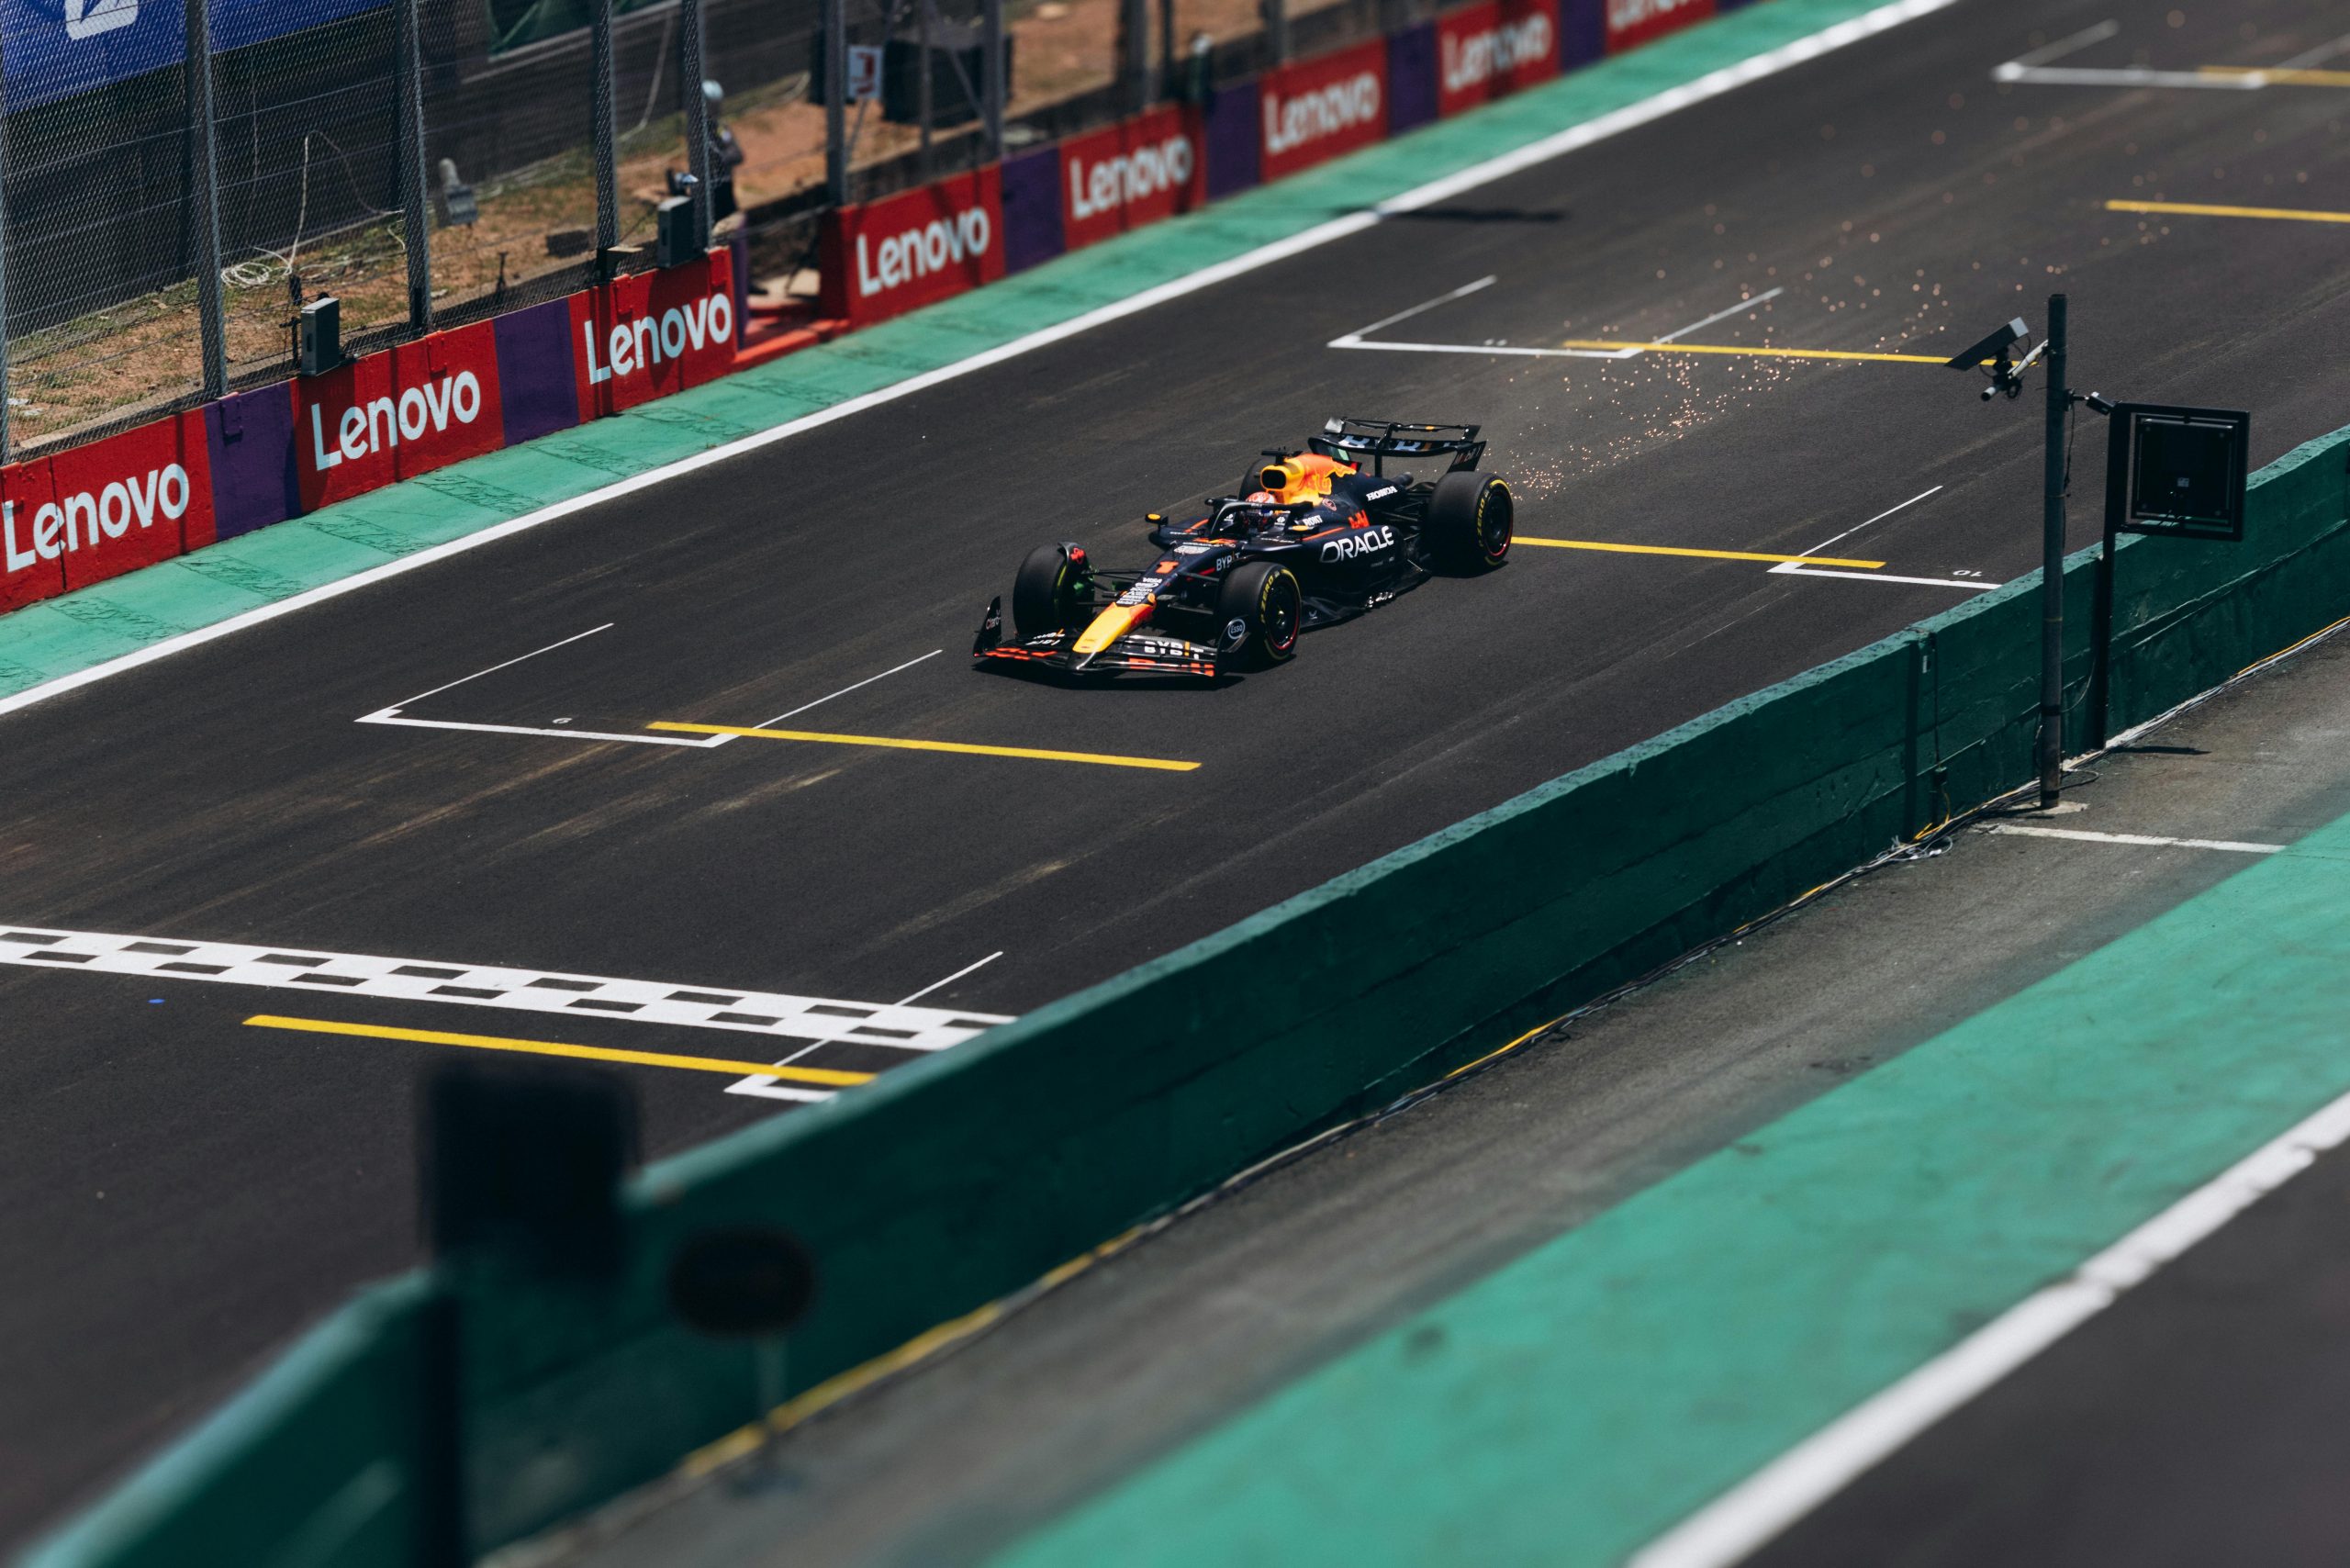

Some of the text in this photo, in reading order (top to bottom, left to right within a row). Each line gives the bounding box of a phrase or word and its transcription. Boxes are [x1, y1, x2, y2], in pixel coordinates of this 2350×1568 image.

[1442, 14, 1552, 90] Lenovo
[1265, 73, 1379, 153] Lenovo
[1070, 138, 1194, 218] Lenovo
[856, 207, 990, 297] Lenovo
[585, 293, 733, 386] Lenovo
[311, 370, 481, 470] Lenovo
[2, 463, 190, 573] Lenovo
[1365, 485, 1398, 501] HONDA
[1319, 525, 1394, 563] ORACLE
